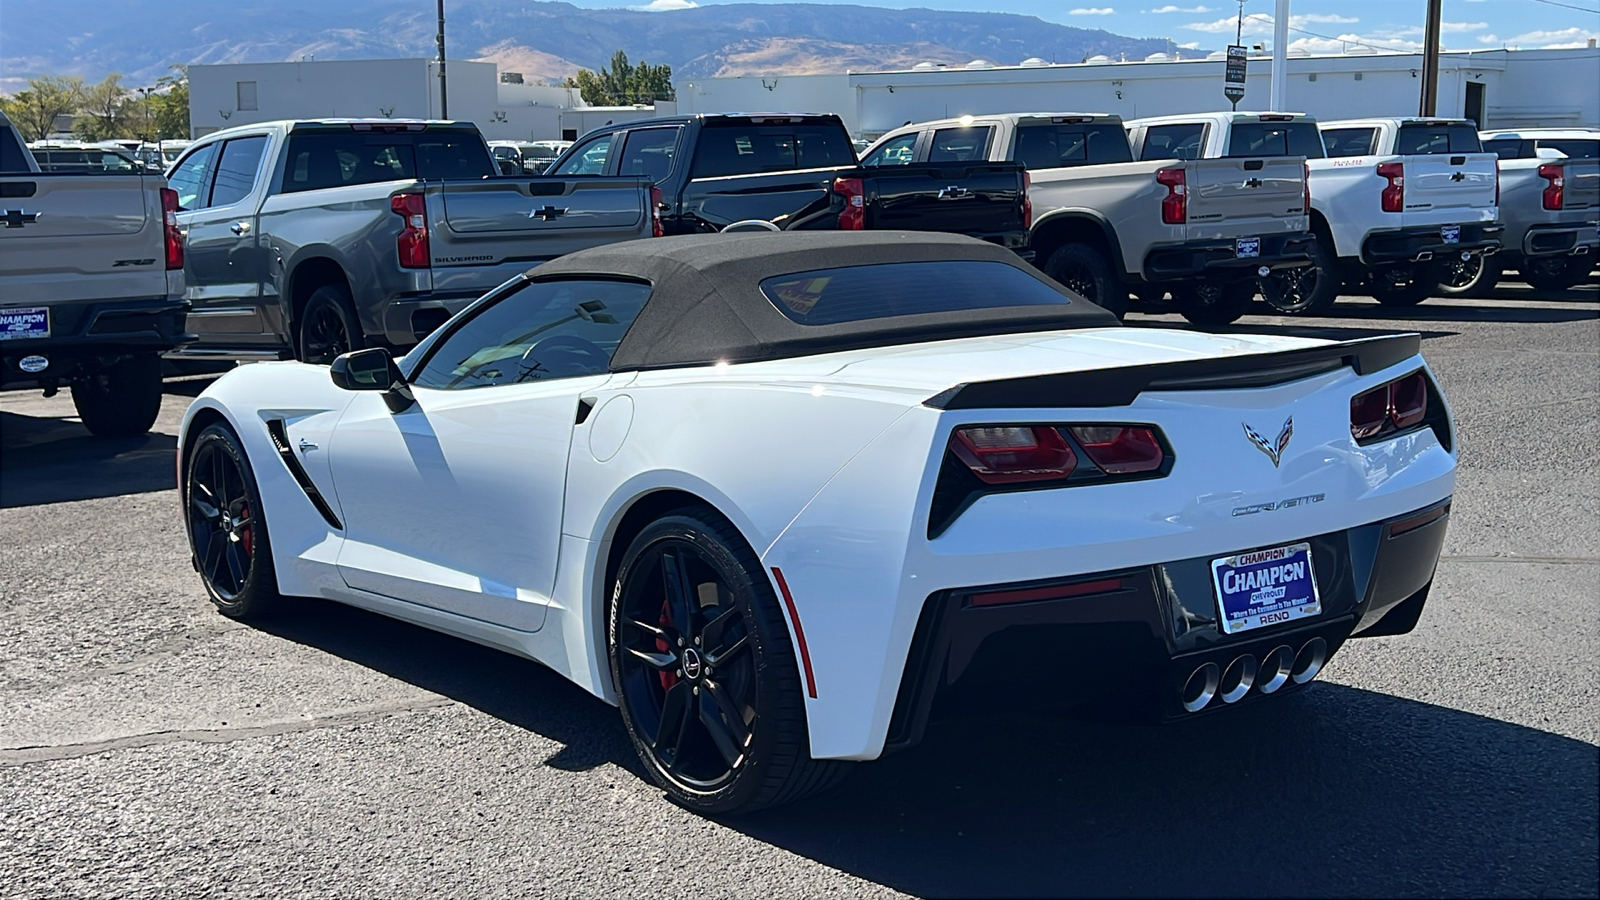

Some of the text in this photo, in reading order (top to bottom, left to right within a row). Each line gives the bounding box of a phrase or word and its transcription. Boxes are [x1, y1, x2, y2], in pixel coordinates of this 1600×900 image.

[434, 255, 493, 263] SILVERADO
[0, 314, 45, 325] HAMPION
[1232, 493, 1326, 517] CORVETTE
[1240, 548, 1285, 566] CHAMPION
[1251, 588, 1284, 602] CHEVROLET
[1257, 603, 1278, 614] Customer
[1283, 600, 1292, 608] The
[1260, 611, 1290, 625] RENO
